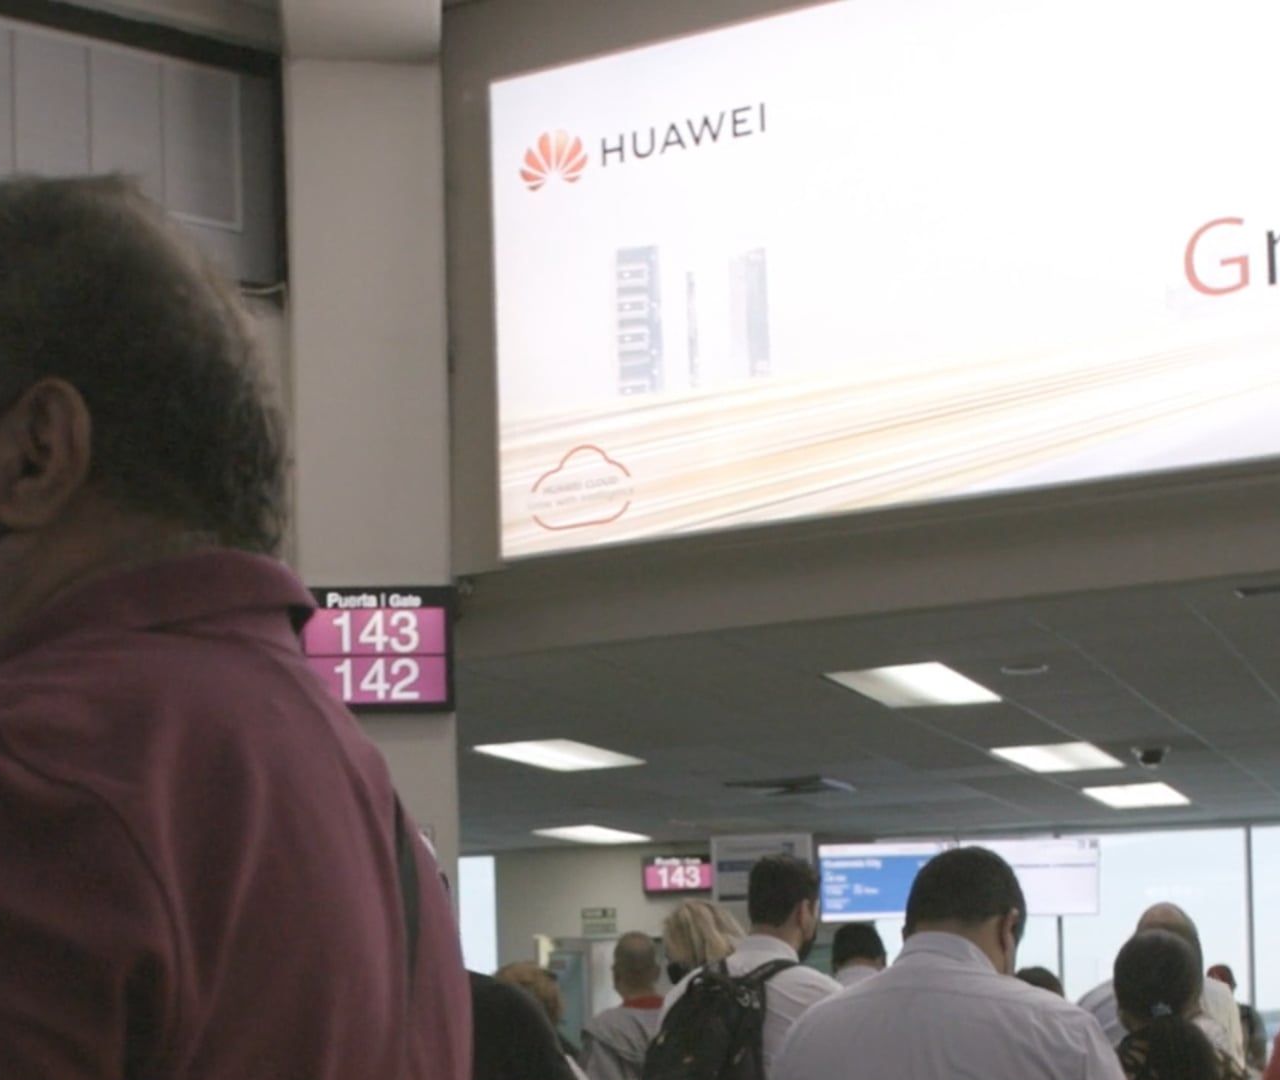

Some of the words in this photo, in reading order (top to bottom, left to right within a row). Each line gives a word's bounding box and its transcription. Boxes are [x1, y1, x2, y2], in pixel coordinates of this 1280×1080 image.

[600, 102, 767, 167] HUAWEI
[326, 592, 378, 608] Puerta
[388, 594, 422, 608] Gate
[332, 610, 419, 653] 143
[333, 658, 420, 700] 142
[657, 866, 701, 889] 143
